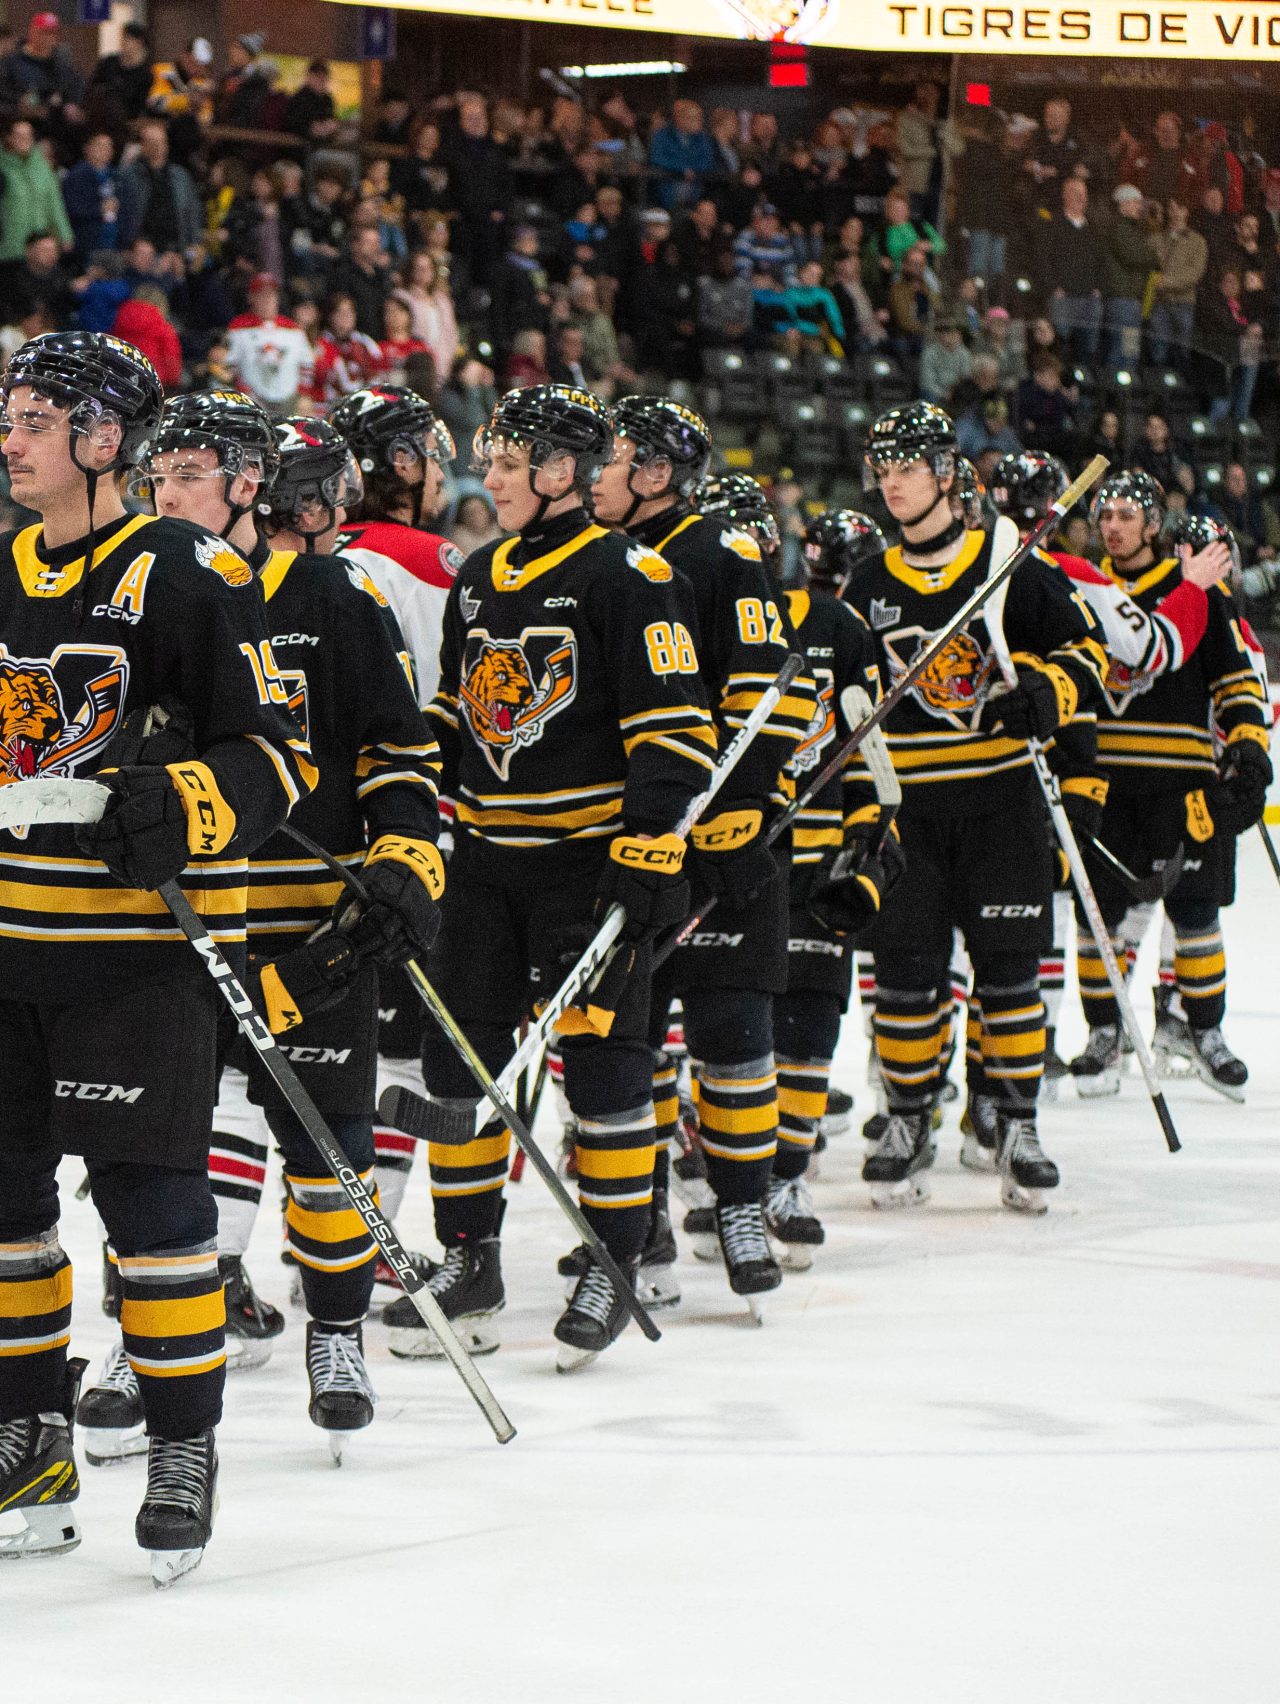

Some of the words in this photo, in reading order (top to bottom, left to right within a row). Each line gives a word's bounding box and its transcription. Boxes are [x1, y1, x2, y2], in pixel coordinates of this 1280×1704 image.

[889, 6, 1091, 40] TIGRES
[1120, 12, 1188, 44] DE
[110, 551, 157, 616] A
[91, 604, 144, 626] CCM
[736, 597, 788, 649] 82
[271, 632, 320, 647] CCM
[644, 621, 699, 675] 88
[807, 646, 835, 657] CC
[238, 640, 289, 705] 19
[178, 768, 217, 852] CCM
[372, 842, 441, 889] CCM
[620, 846, 684, 865] CCM
[980, 905, 1043, 918] CCM
[788, 938, 845, 957] CCM
[192, 935, 275, 1050] CCM
[277, 1045, 352, 1065] CM
[55, 1079, 146, 1104] CCM
[328, 1147, 347, 1170] FTS
[338, 1166, 419, 1284] JETSPEED
